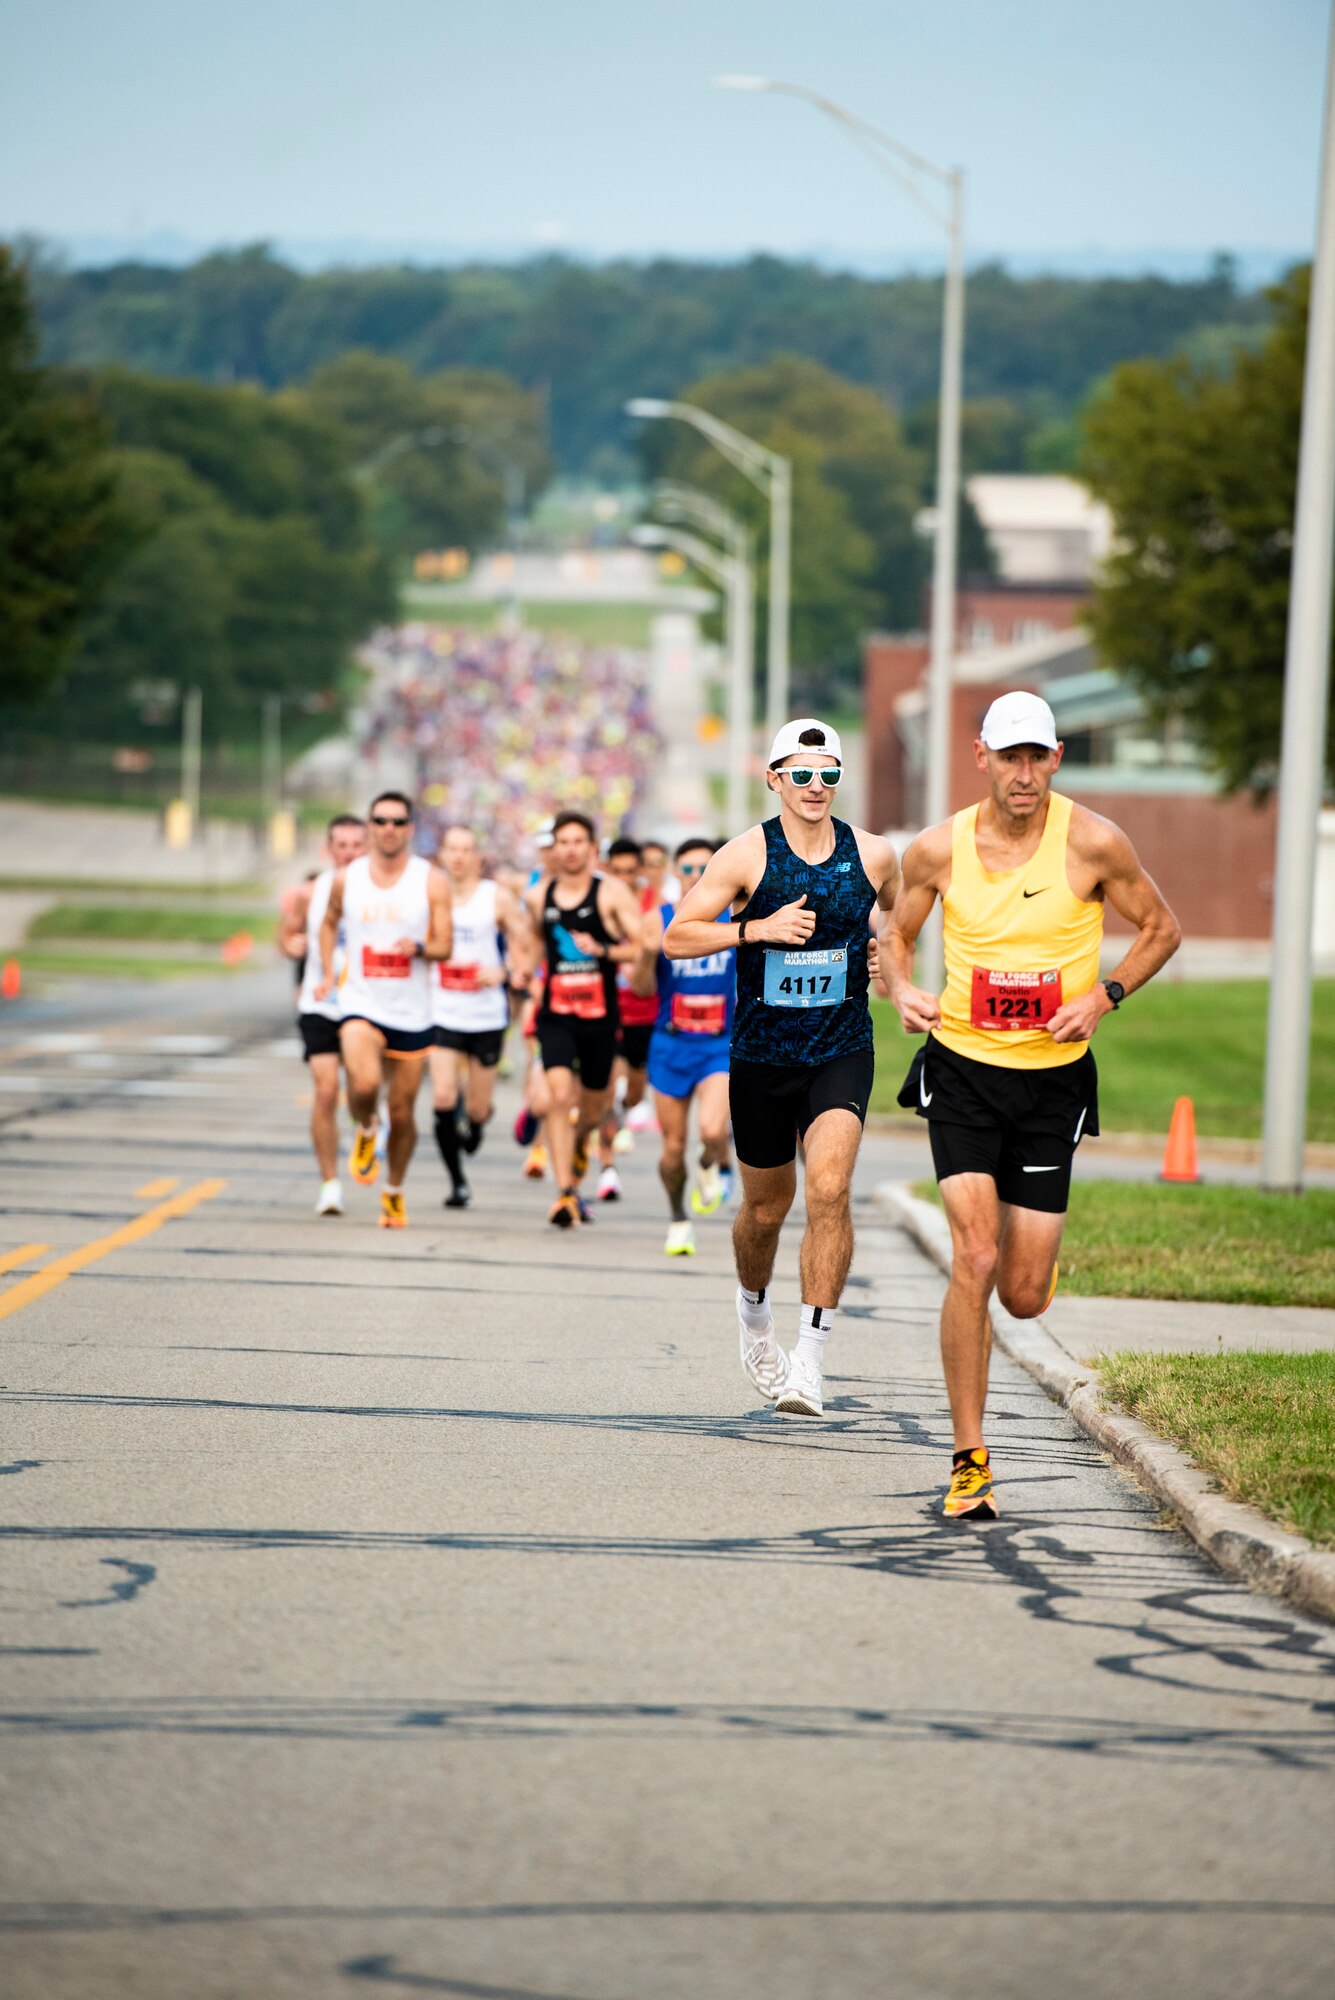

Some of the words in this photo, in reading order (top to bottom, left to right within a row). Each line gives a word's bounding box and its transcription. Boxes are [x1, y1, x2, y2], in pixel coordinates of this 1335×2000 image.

[801, 951, 828, 959] FORCE
[784, 958, 828, 966] MARATHON
[779, 976, 832, 994] 4117
[999, 987, 1030, 995] Dustin
[986, 997, 1041, 1017] 1221
